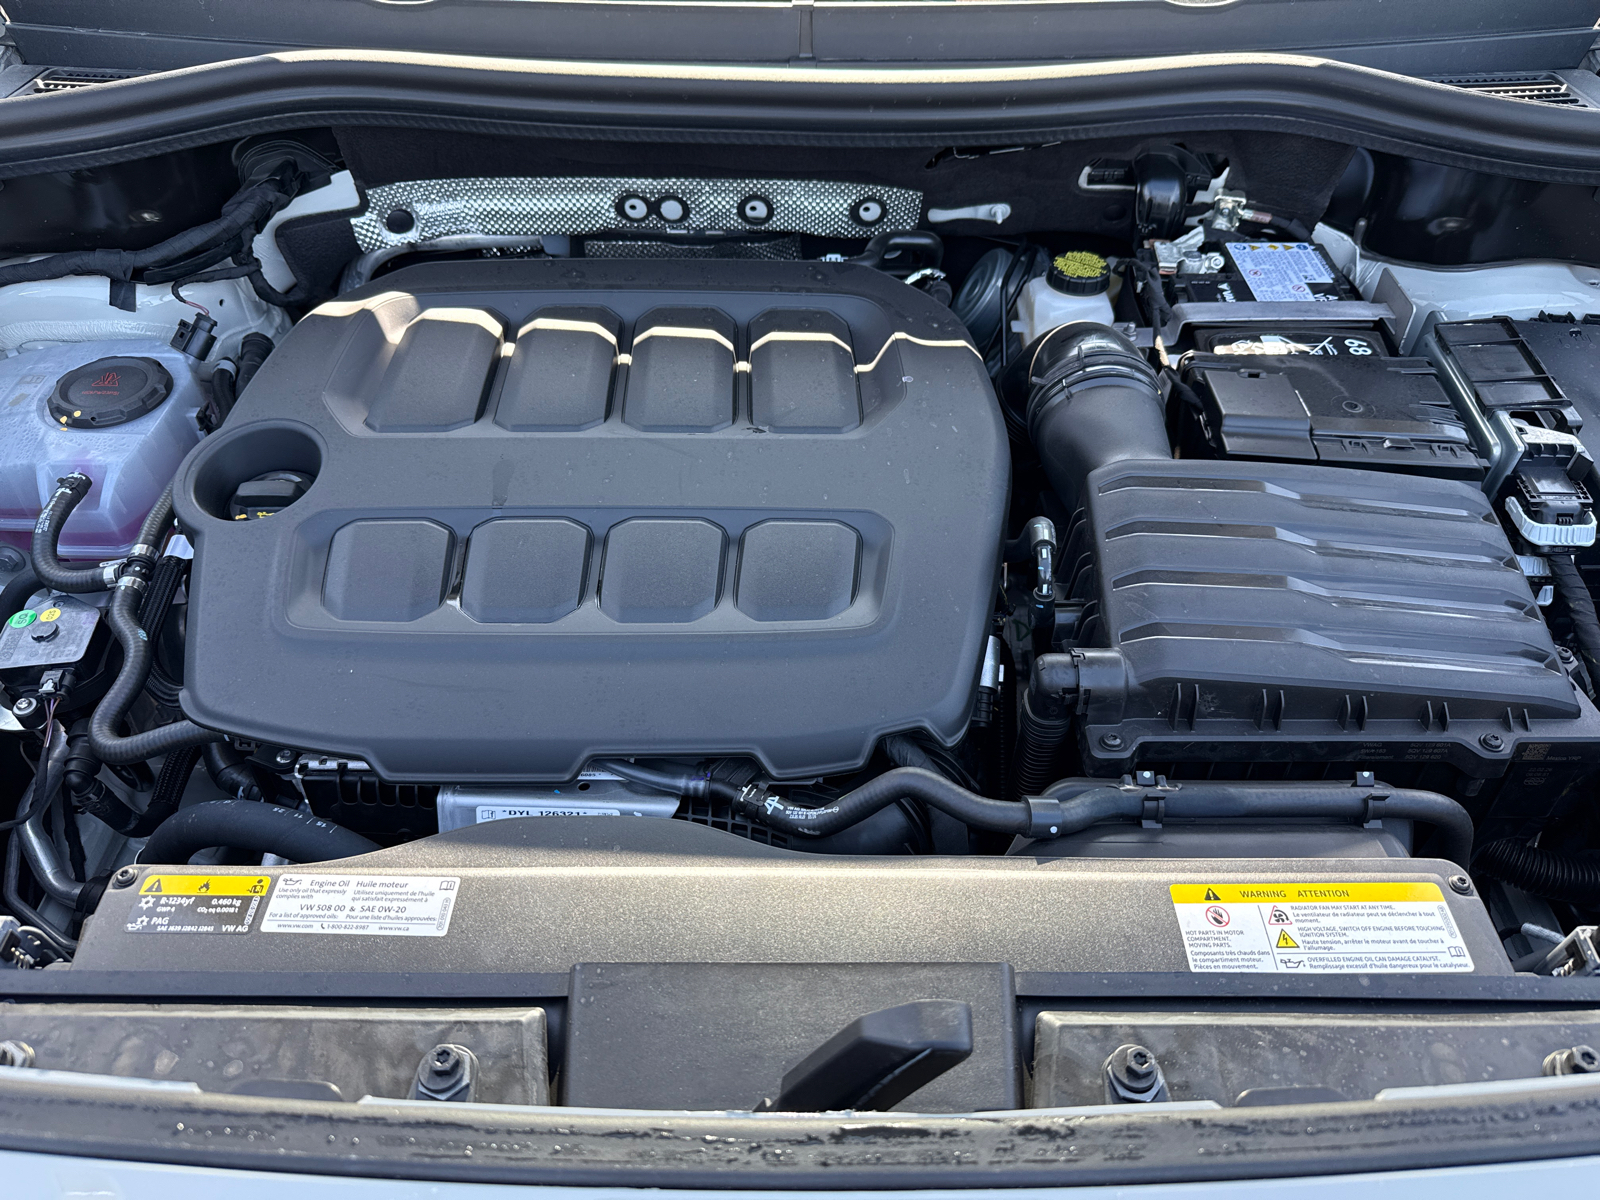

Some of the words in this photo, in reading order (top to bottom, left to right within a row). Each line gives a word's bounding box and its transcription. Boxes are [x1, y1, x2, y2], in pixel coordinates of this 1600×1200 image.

[1344, 339, 1373, 355] 68
[310, 880, 337, 888] Engine
[356, 880, 378, 888] Huile
[1239, 890, 1287, 898] WARNING
[1297, 889, 1350, 898] ATTENTION
[159, 896, 195, 906] R-1234yf
[211, 898, 231, 906] 0.460
[232, 898, 242, 907] kg
[333, 904, 346, 912] 00
[359, 905, 376, 913] SAE
[377, 905, 407, 913] 0W-20
[151, 916, 169, 925] PAG
[300, 912, 326, 920] approved
[221, 924, 236, 932] VW
[236, 924, 249, 932] AG
